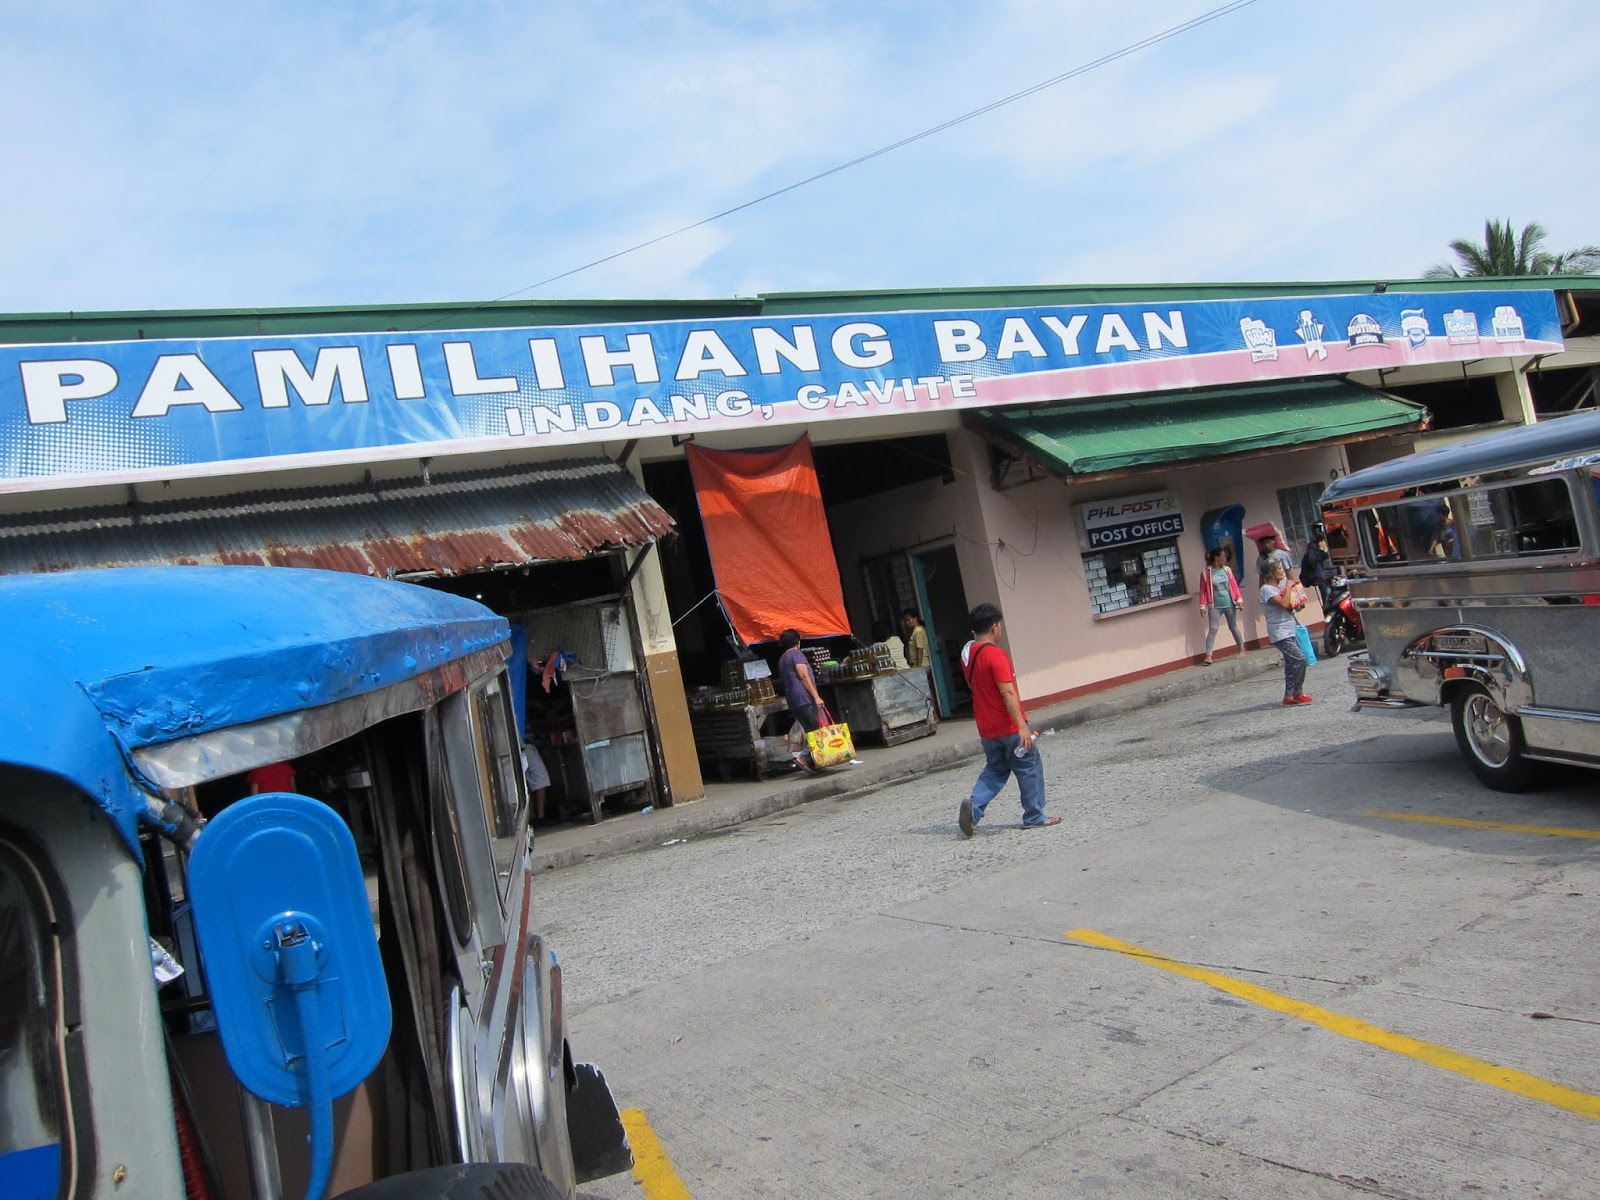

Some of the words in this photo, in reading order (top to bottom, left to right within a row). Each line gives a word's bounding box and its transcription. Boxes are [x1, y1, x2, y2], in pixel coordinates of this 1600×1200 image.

[1347, 323, 1383, 337] BIGTIME
[19, 321, 895, 425] PAMILIHANG
[932, 310, 1188, 363] BAYAN
[504, 390, 773, 436] INDANG,
[796, 374, 977, 411] CAVITE
[1087, 498, 1164, 520] PHLPOST
[1091, 527, 1128, 545] POST
[1131, 518, 1182, 537] OFFICE
